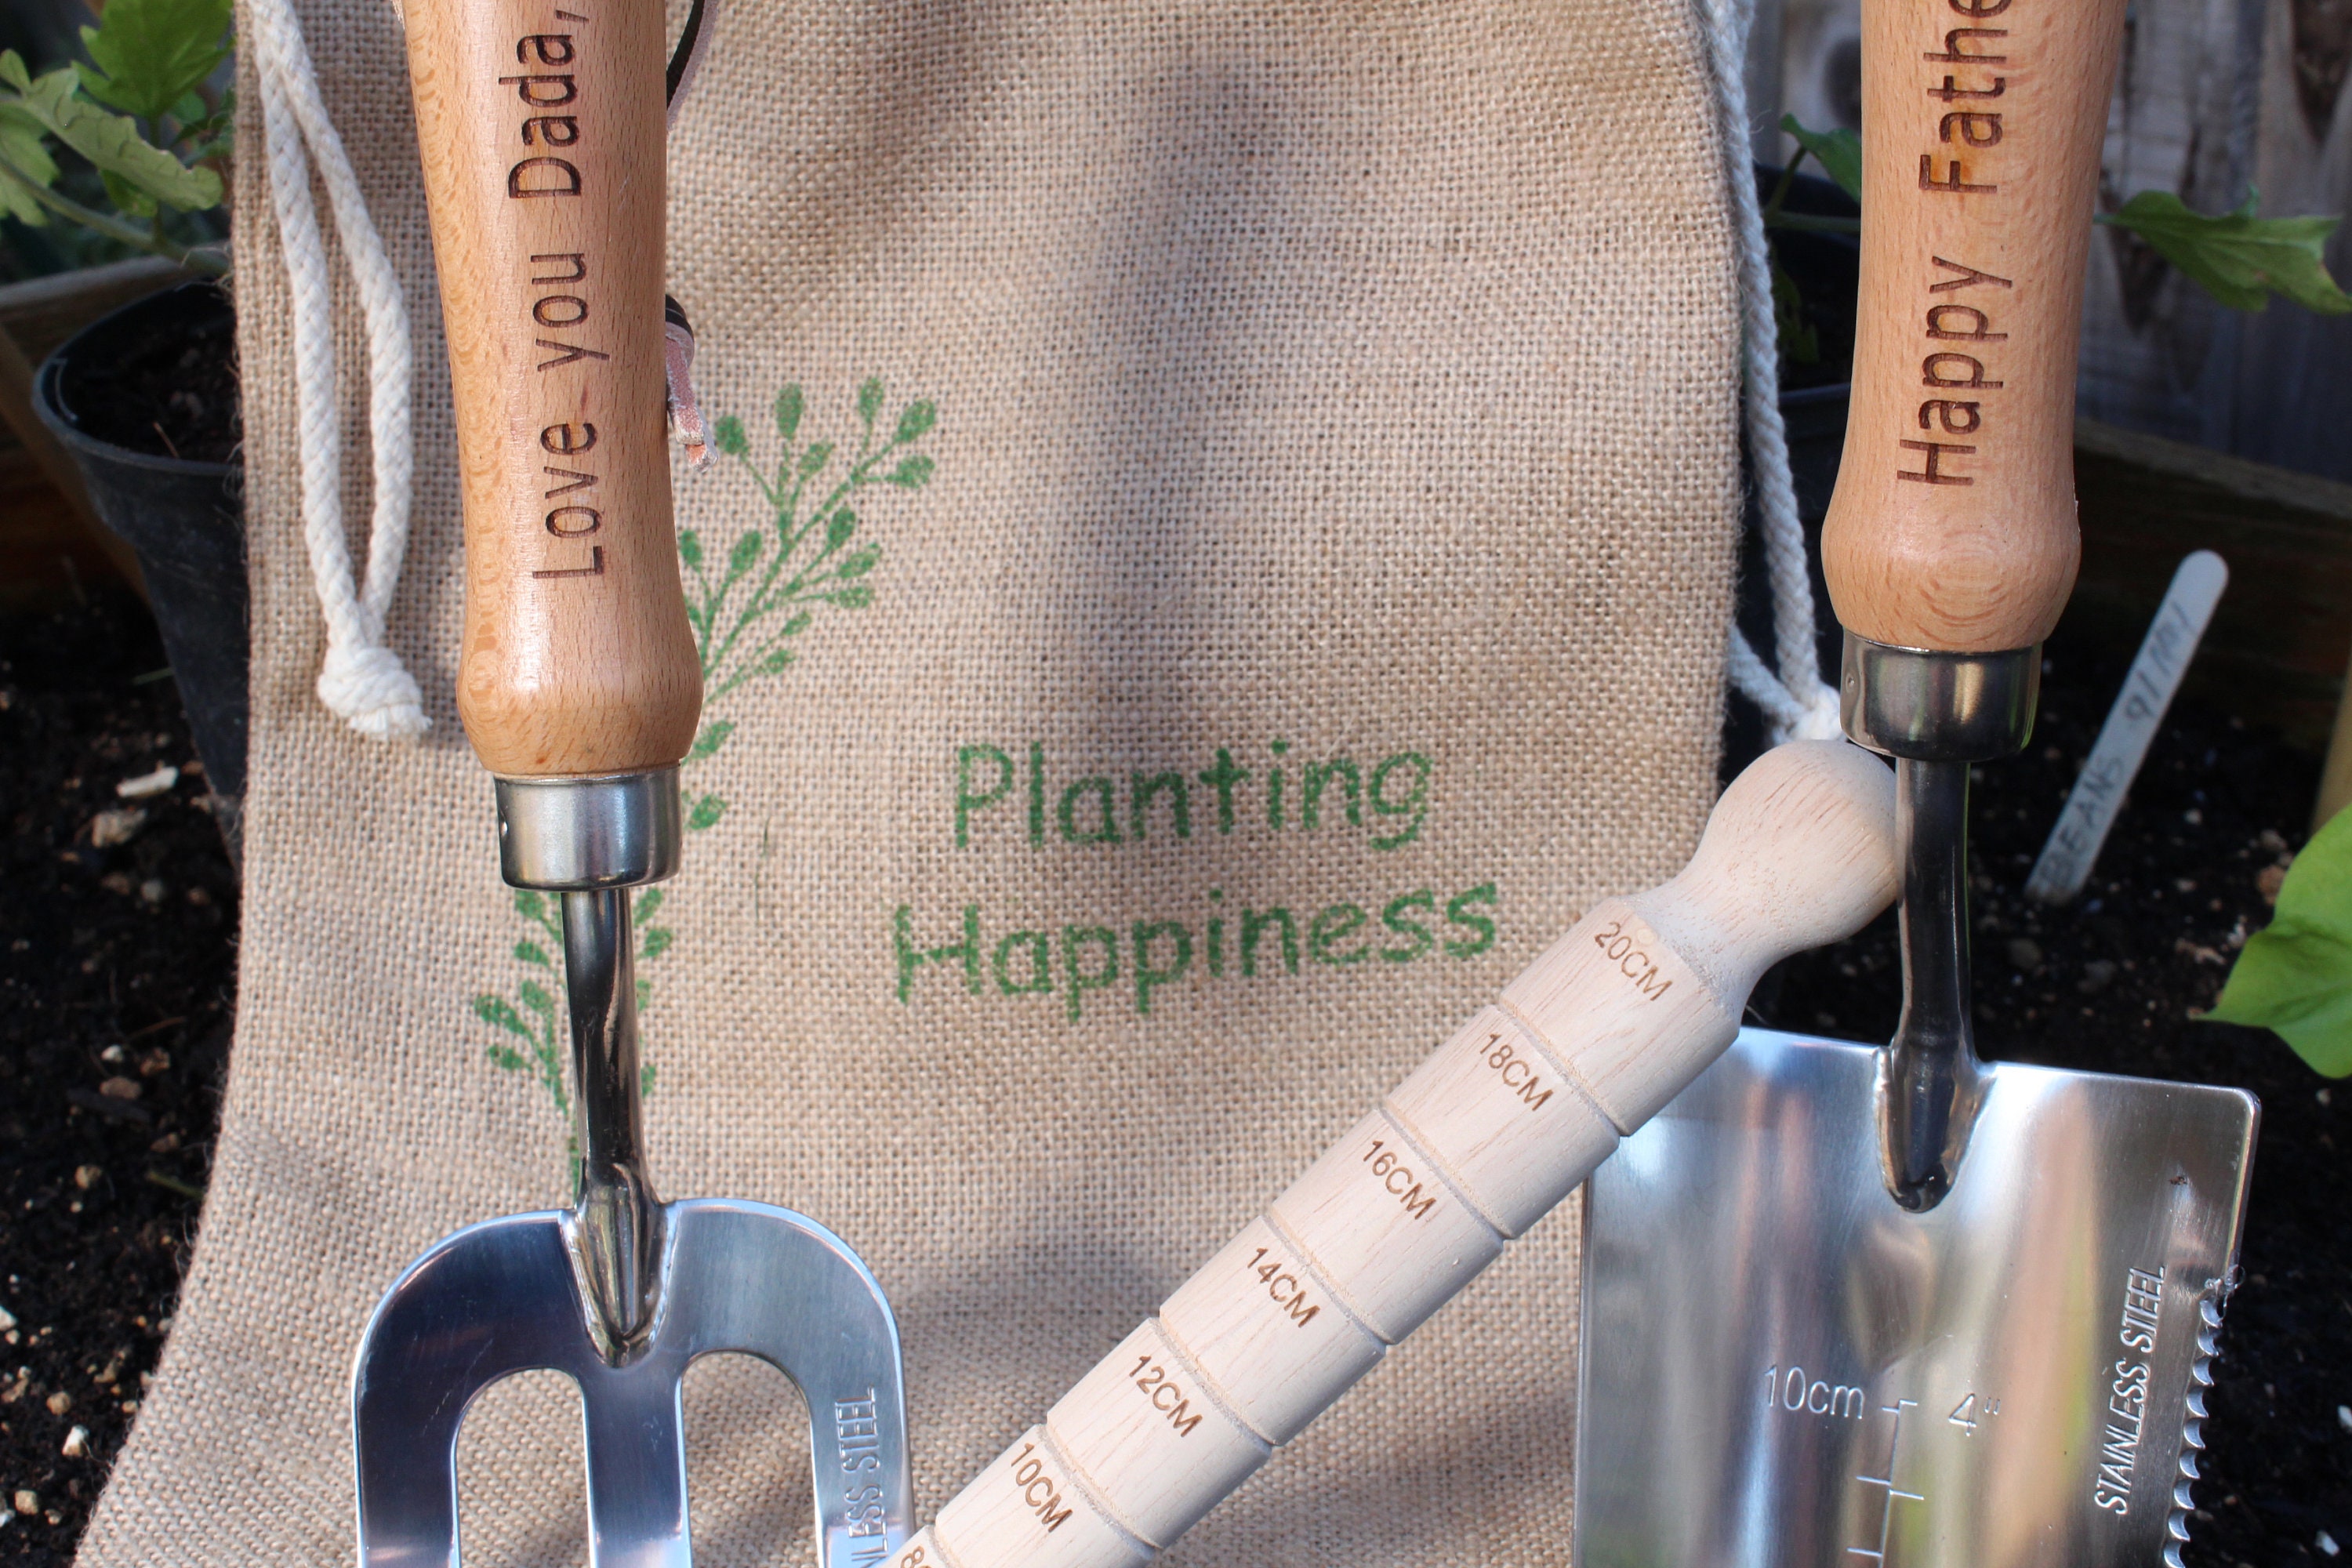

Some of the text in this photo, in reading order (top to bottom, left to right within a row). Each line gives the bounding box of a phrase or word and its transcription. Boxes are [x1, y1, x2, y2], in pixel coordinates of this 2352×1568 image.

[498, 9, 610, 579] Love you Dada,
[1896, 256, 2013, 484] Happy
[956, 739, 1432, 851] Planting
[895, 881, 1497, 1023] Happiness
[1595, 921, 1672, 1002] 20CM
[1479, 1032, 1555, 1112] 18CM
[1363, 1140, 1436, 1221] 16CM
[1247, 1247, 1320, 1329] 14CM
[835, 1385, 880, 1474] STEEL
[1129, 1356, 1203, 1437] 12CM
[1765, 1364, 1866, 1420] 10cm
[2094, 1265, 2165, 1515] STAINLESS STEEL
[1011, 1443, 1073, 1534] 10CM
